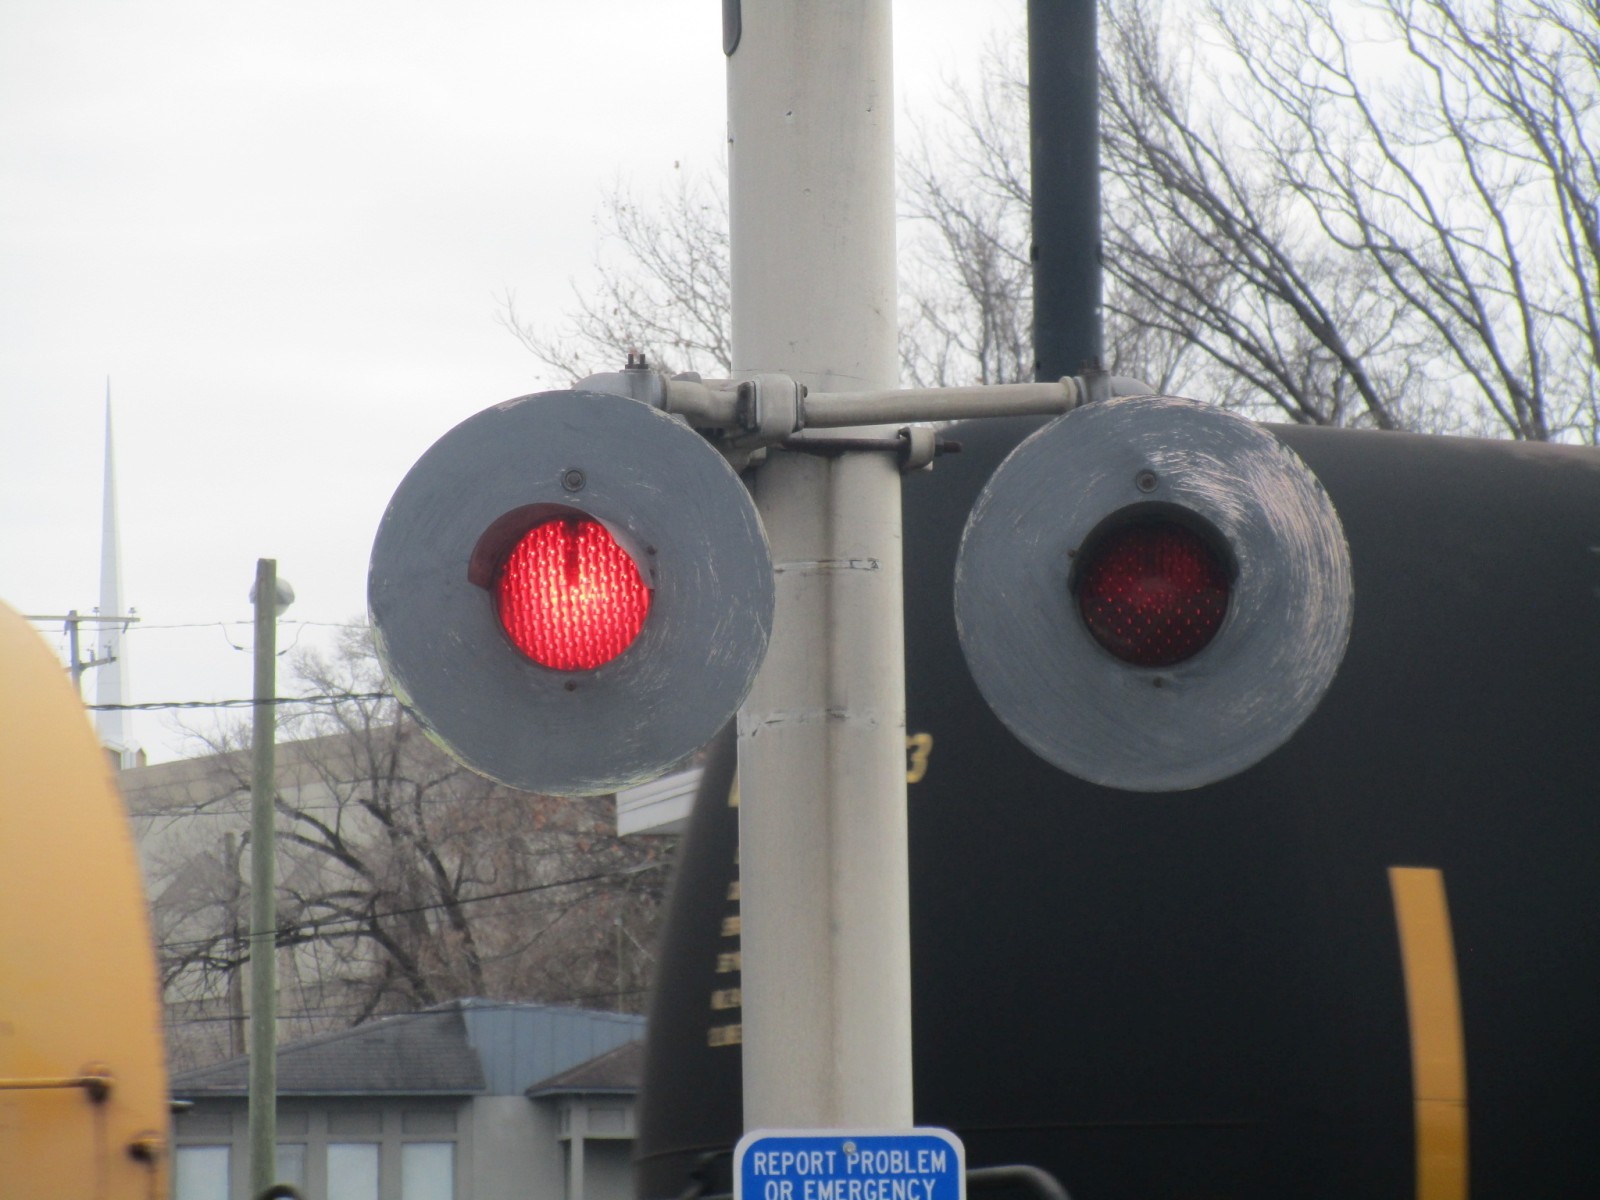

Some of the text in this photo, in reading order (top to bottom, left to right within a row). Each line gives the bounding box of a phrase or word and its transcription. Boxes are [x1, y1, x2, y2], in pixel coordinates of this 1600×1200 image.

[754, 1150, 946, 1175] REPORT PROBLEM
[765, 1179, 936, 1200] OR EMERGENCY
